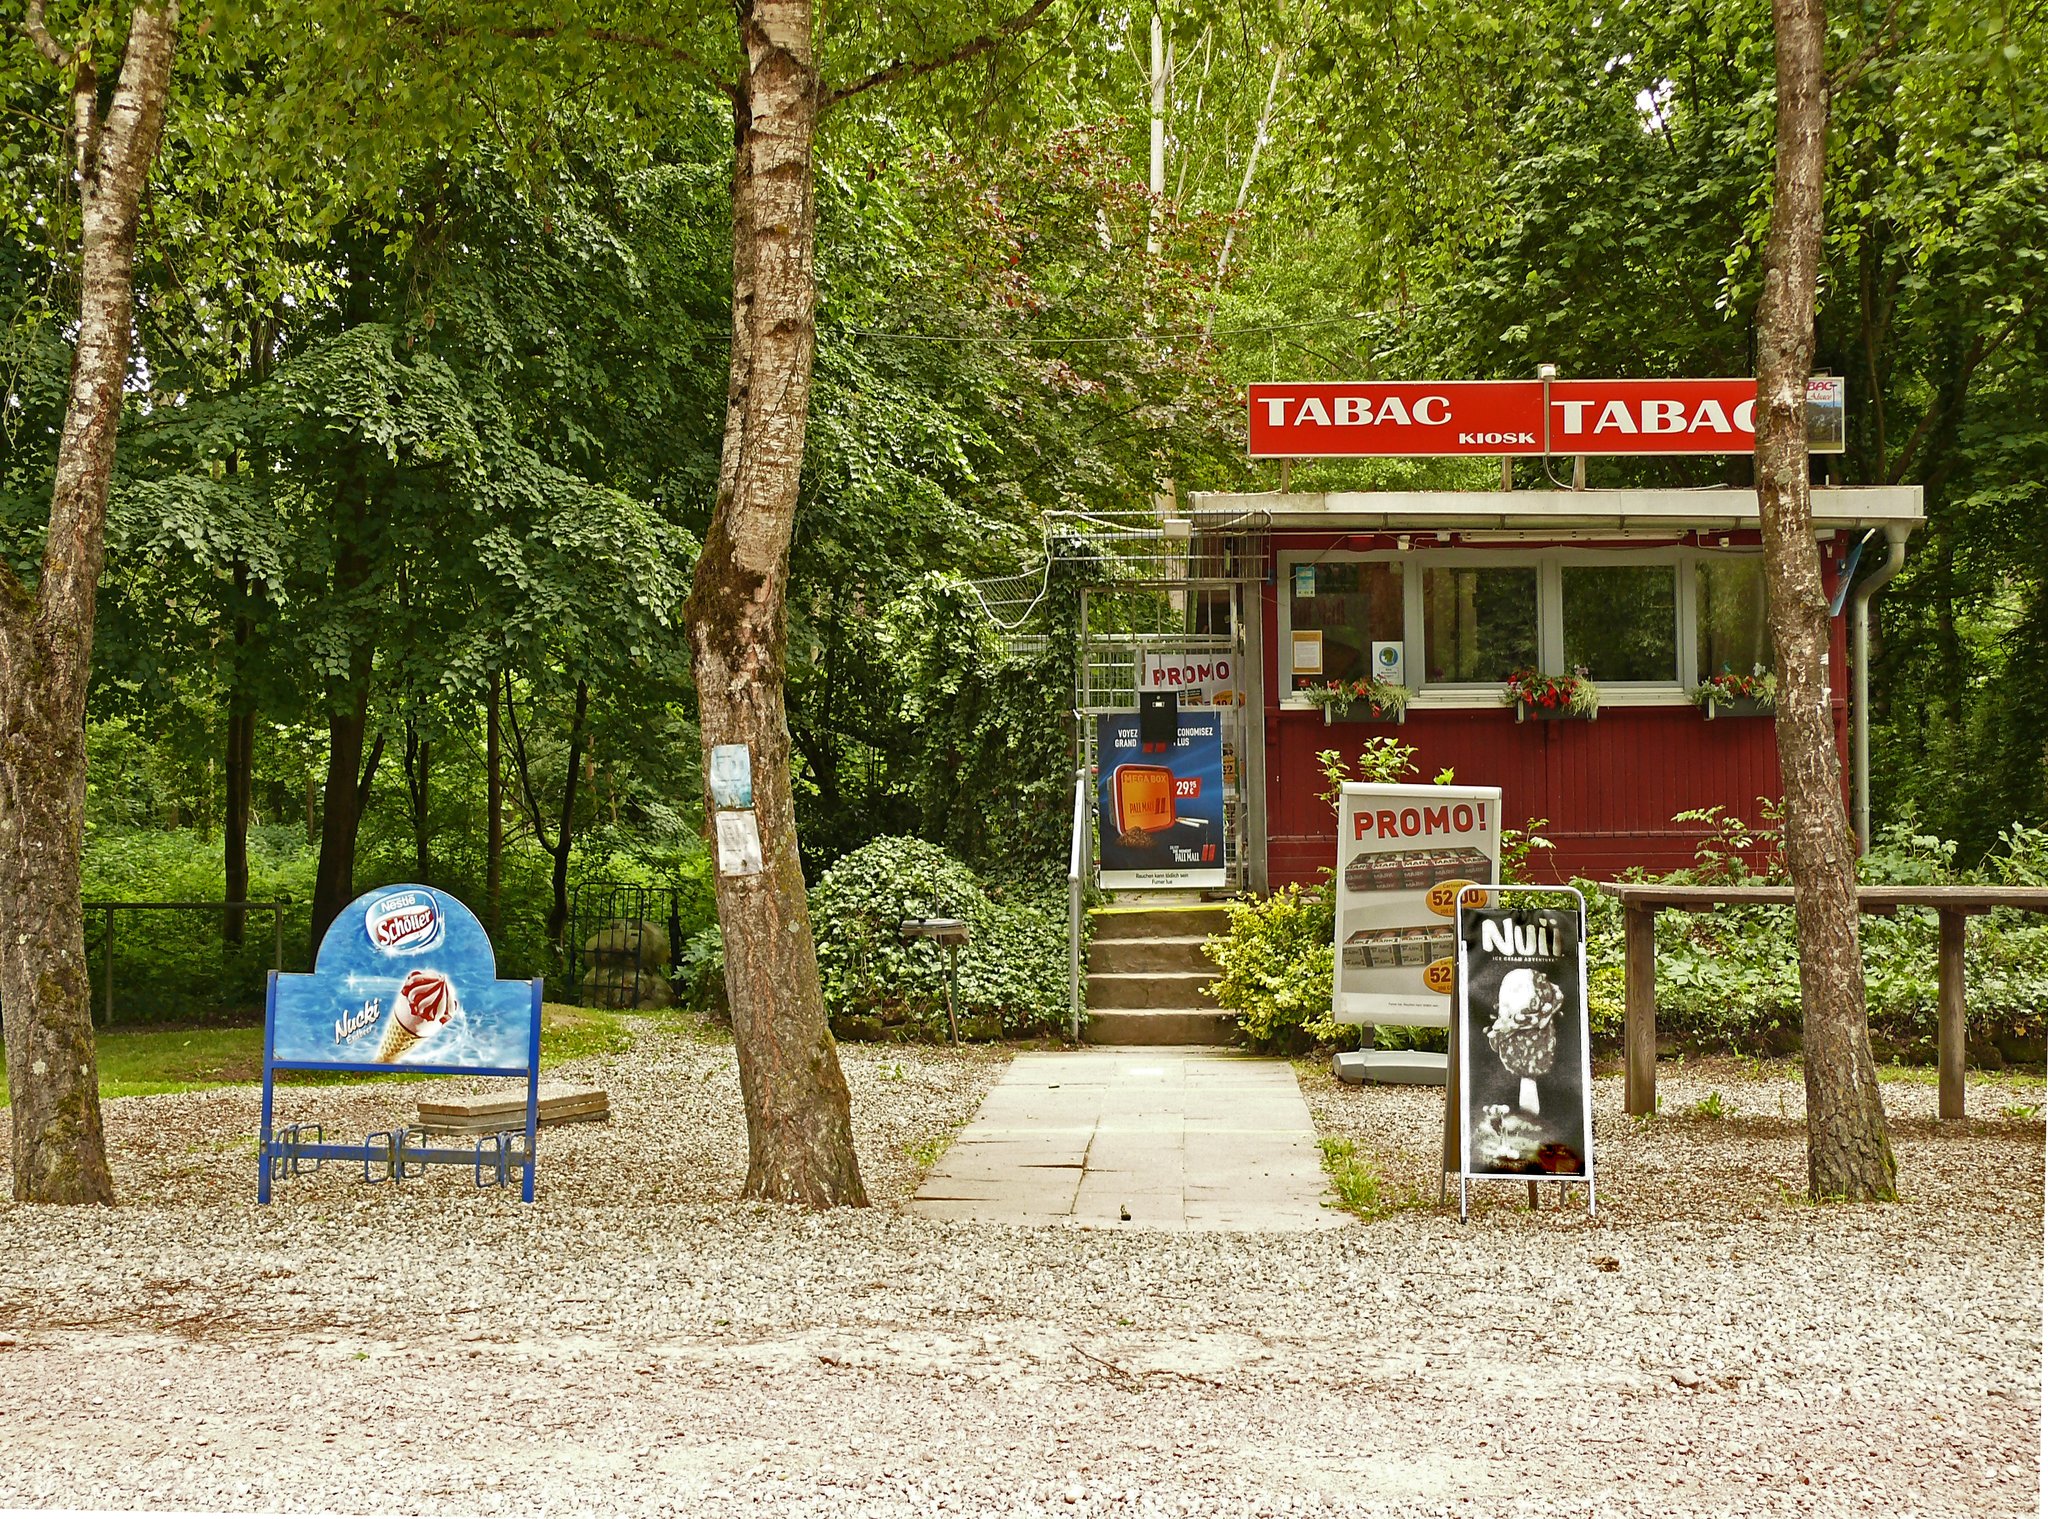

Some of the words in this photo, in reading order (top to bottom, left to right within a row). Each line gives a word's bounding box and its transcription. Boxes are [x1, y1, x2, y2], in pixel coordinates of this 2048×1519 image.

[1257, 396, 1452, 427] TABAC
[1458, 432, 1536, 444] KIOSK
[1152, 661, 1230, 686] PROMO
[1115, 738, 1137, 748] GRAND
[1176, 737, 1190, 747] LUS
[1118, 729, 1138, 738] VOYEZ
[1177, 727, 1213, 737] CONOMISEZ
[1123, 774, 1149, 784] MEGA
[1150, 774, 1167, 784] BOX
[1353, 802, 1486, 841] PROMO!
[377, 910, 431, 946] Schöller
[1482, 917, 1562, 957] Nuii
[1430, 966, 1451, 983] 52
[335, 997, 380, 1045] Nucki
